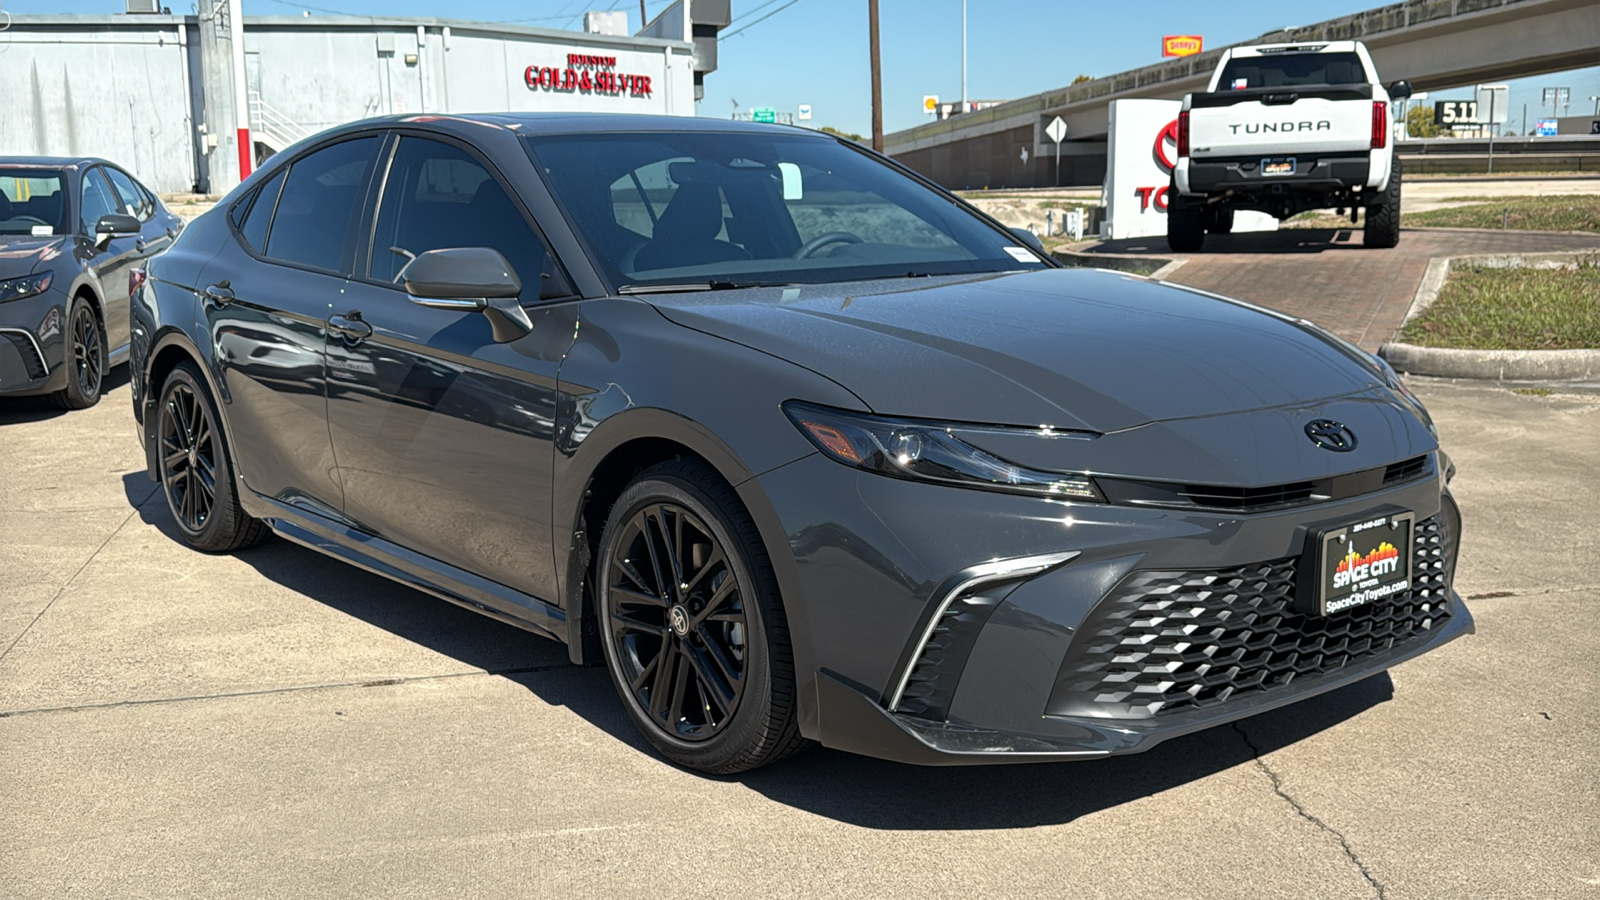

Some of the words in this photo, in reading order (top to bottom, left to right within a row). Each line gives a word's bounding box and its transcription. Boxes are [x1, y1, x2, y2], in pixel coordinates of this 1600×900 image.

[567, 53, 617, 67] HOUSTON
[525, 65, 578, 89] GOLD
[595, 71, 653, 94] SILVER
[1442, 102, 1478, 124] 5.11
[1228, 120, 1331, 135] TUNDRA
[1333, 563, 1370, 589] SPACE
[1370, 556, 1399, 577] CITY
[1359, 578, 1379, 589] TOYOTA
[1326, 580, 1408, 613] SpaceCityToyota.com
